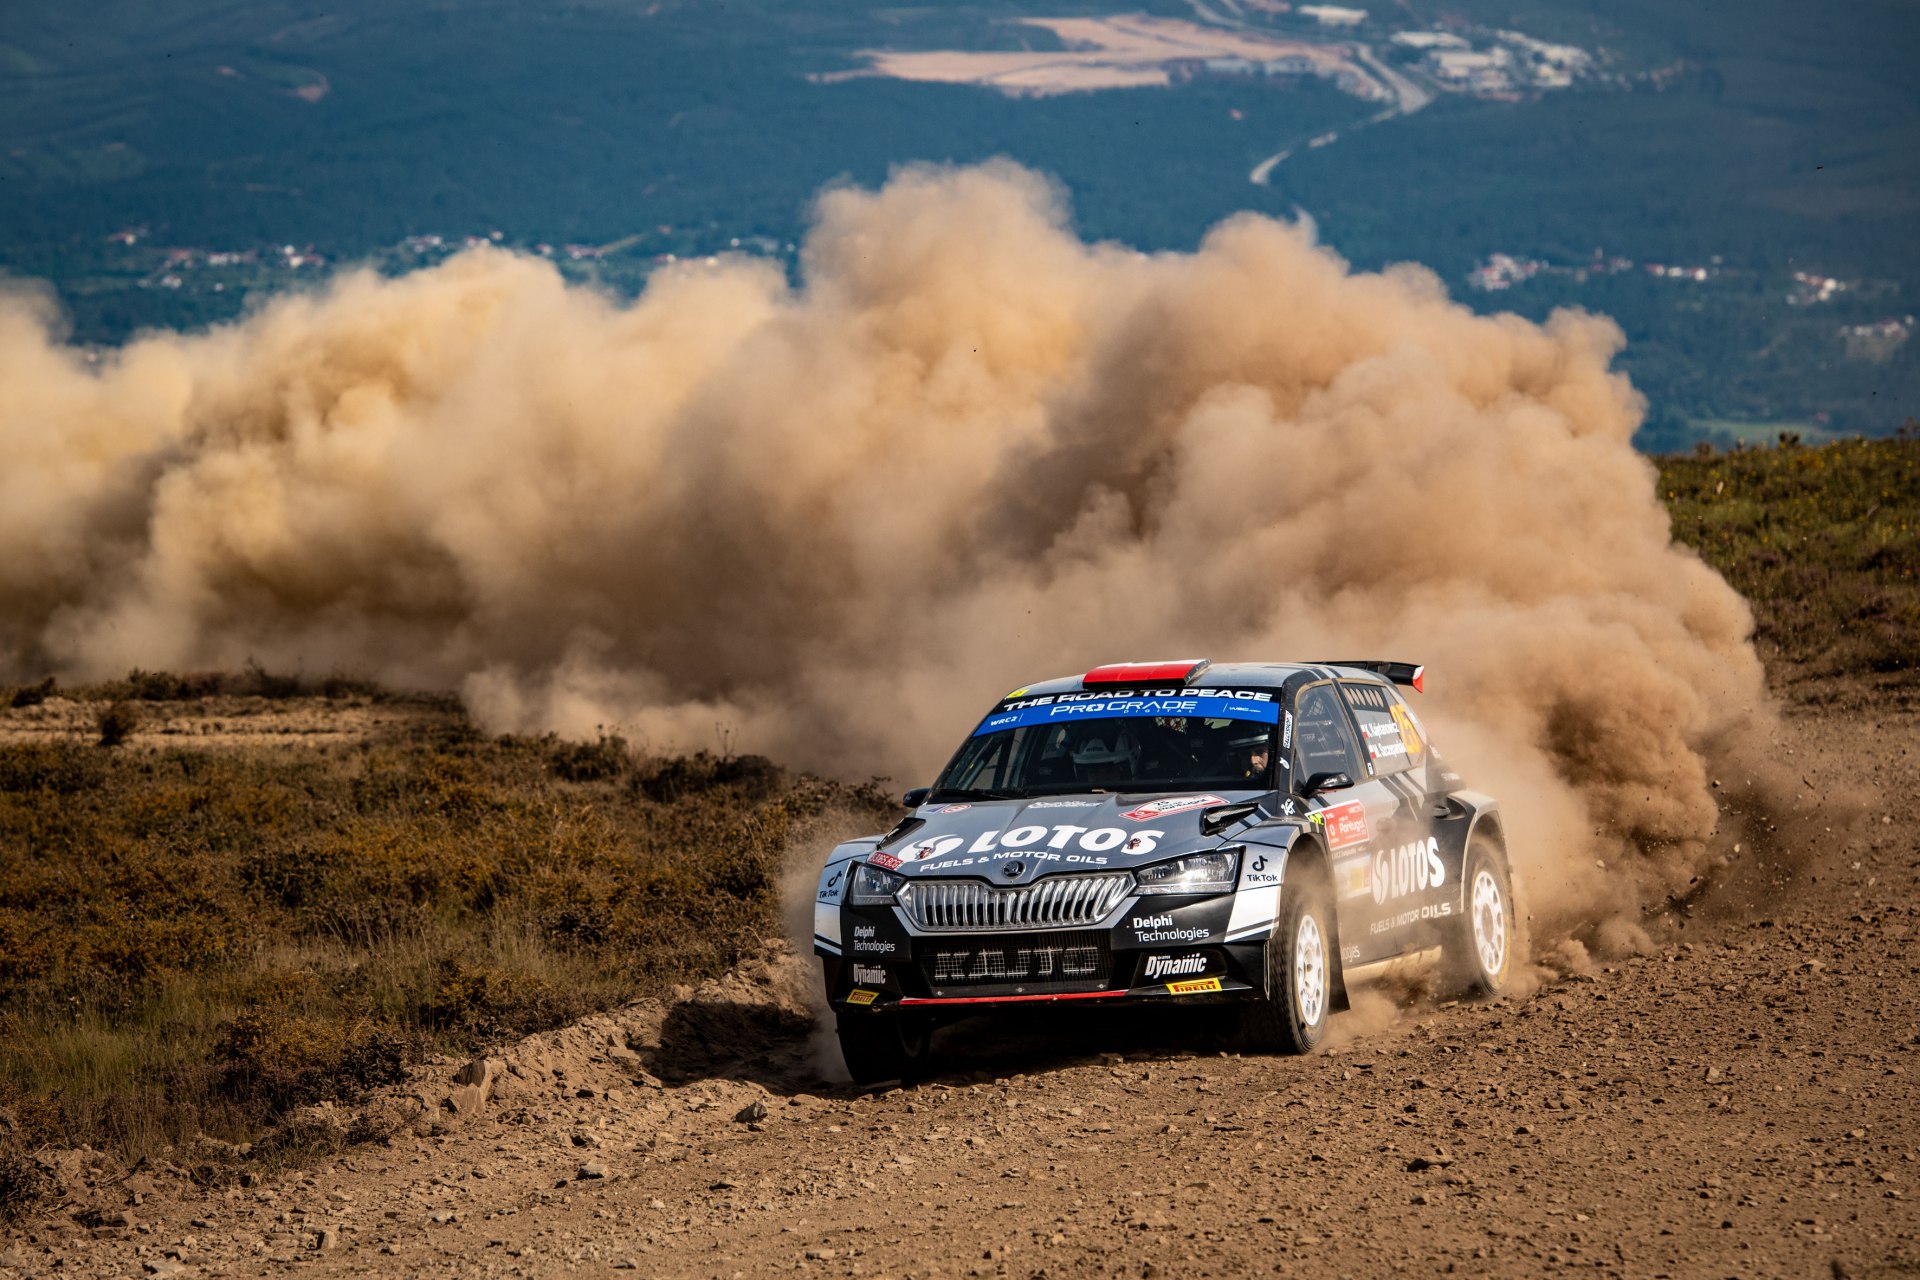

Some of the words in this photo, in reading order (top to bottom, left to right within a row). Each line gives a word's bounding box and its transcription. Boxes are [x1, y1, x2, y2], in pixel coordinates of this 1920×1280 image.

[1004, 696, 1055, 711] THE
[1057, 690, 1134, 704] ROAD
[1137, 689, 1176, 697] TO
[1180, 689, 1273, 702] PEACE
[990, 716, 1017, 726] WRC2
[1339, 818, 1365, 833] Portugal
[967, 825, 1165, 855] LOTOS
[919, 857, 973, 872] FUELS
[978, 855, 990, 865] &
[993, 851, 1060, 861] MOTOR
[1065, 854, 1108, 865] OILS
[1390, 837, 1445, 899] LOTOS
[1247, 874, 1278, 882] TikTok
[819, 889, 838, 898] TikTok
[1133, 914, 1172, 929] Delphi
[1370, 918, 1390, 935] FUELS
[1396, 909, 1419, 928] MOTOR
[1421, 903, 1451, 918] OILS
[854, 926, 875, 939] Delphi
[1135, 927, 1210, 943] Technologies
[854, 940, 895, 953] Technologies
[1145, 953, 1207, 979] Dynamic
[853, 963, 886, 986] Dynamic
[1173, 981, 1216, 993] PIRELLI
